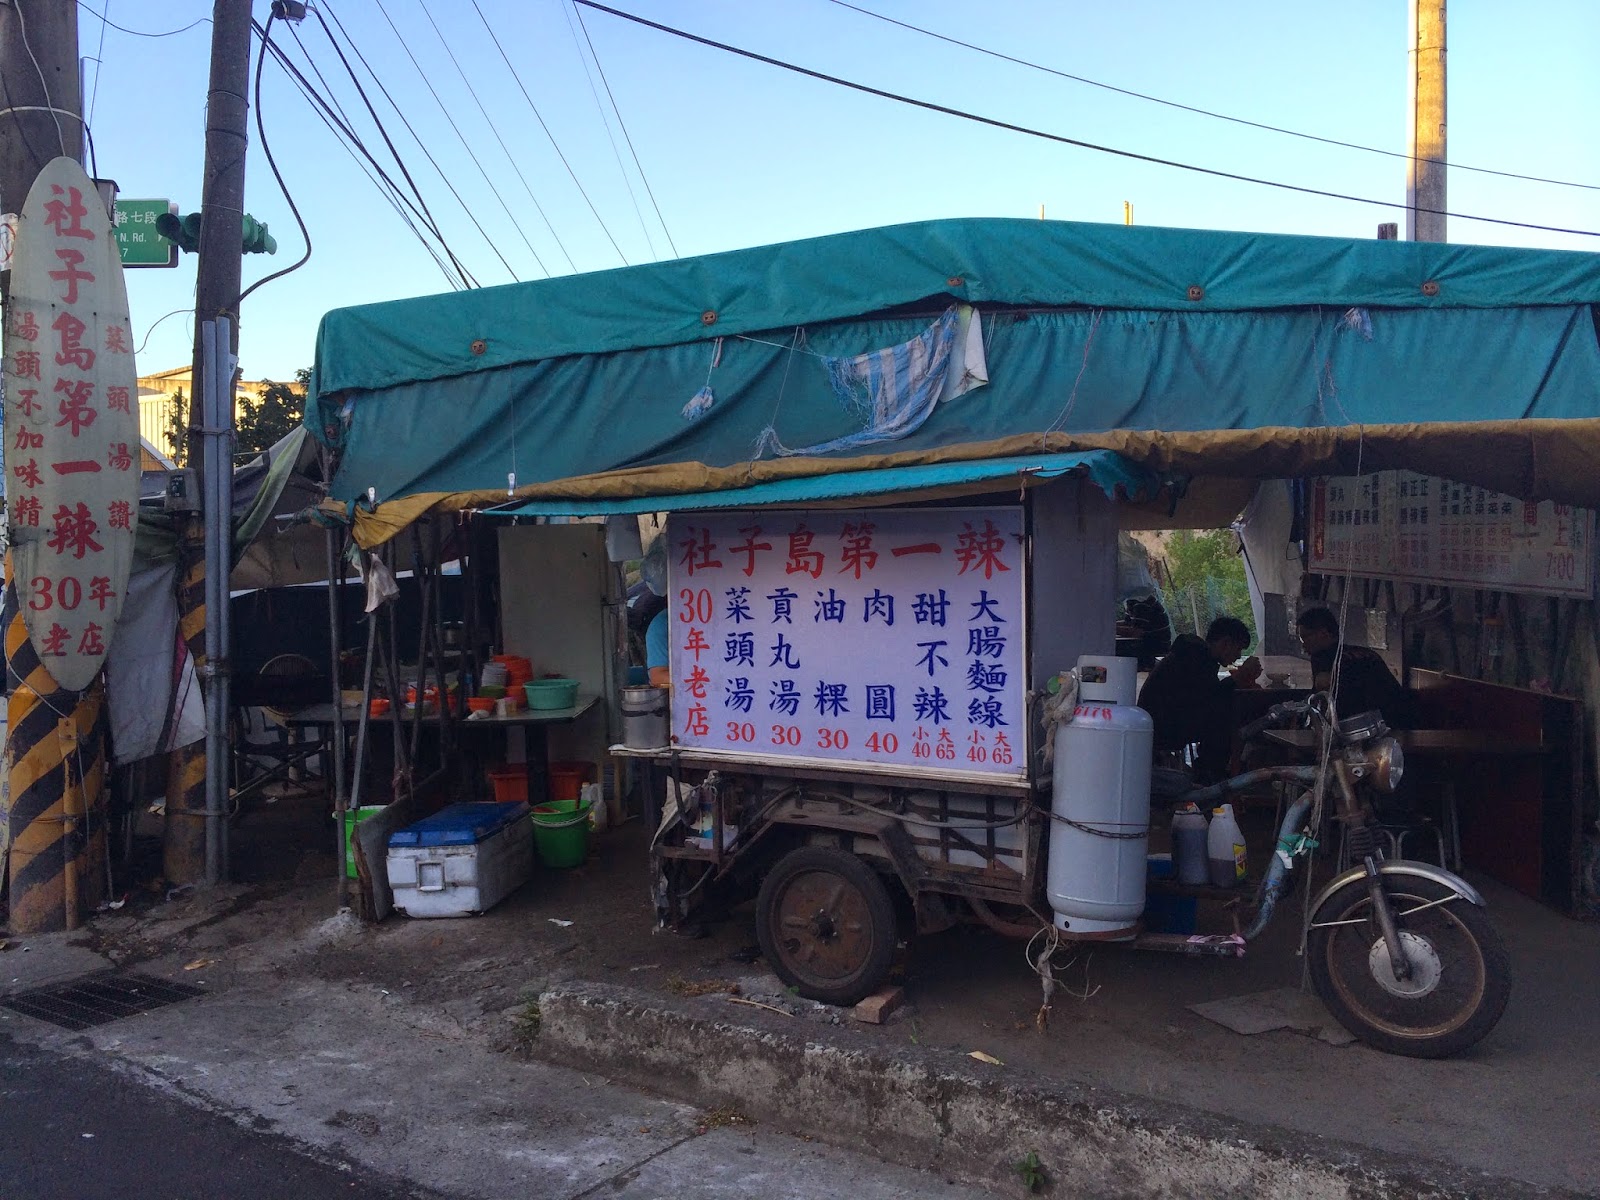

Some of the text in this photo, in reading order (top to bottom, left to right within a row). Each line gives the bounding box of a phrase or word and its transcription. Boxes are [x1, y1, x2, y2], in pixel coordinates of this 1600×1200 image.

[133, 233, 147, 242] Rd.
[44, 184, 104, 560] 社子島第一辣
[14, 311, 44, 527] 湯頭不加味精
[680, 520, 1011, 580] 社子島第一辣
[29, 576, 116, 612] 30年
[42, 622, 105, 656] 老店
[724, 587, 755, 713] 菜頭湯
[766, 587, 801, 716] 貢丸湯
[679, 588, 713, 737] 30年老店
[911, 588, 953, 725] 甜不辣
[966, 590, 1010, 729] 大腸麵線
[726, 722, 756, 743] 30
[771, 724, 801, 746] 30
[817, 728, 849, 750] 30
[865, 731, 899, 754] 40
[912, 726, 953, 743] 小 大
[967, 730, 1010, 747] 小 大
[912, 742, 956, 760] 40 65
[966, 746, 1013, 765] 40 65
